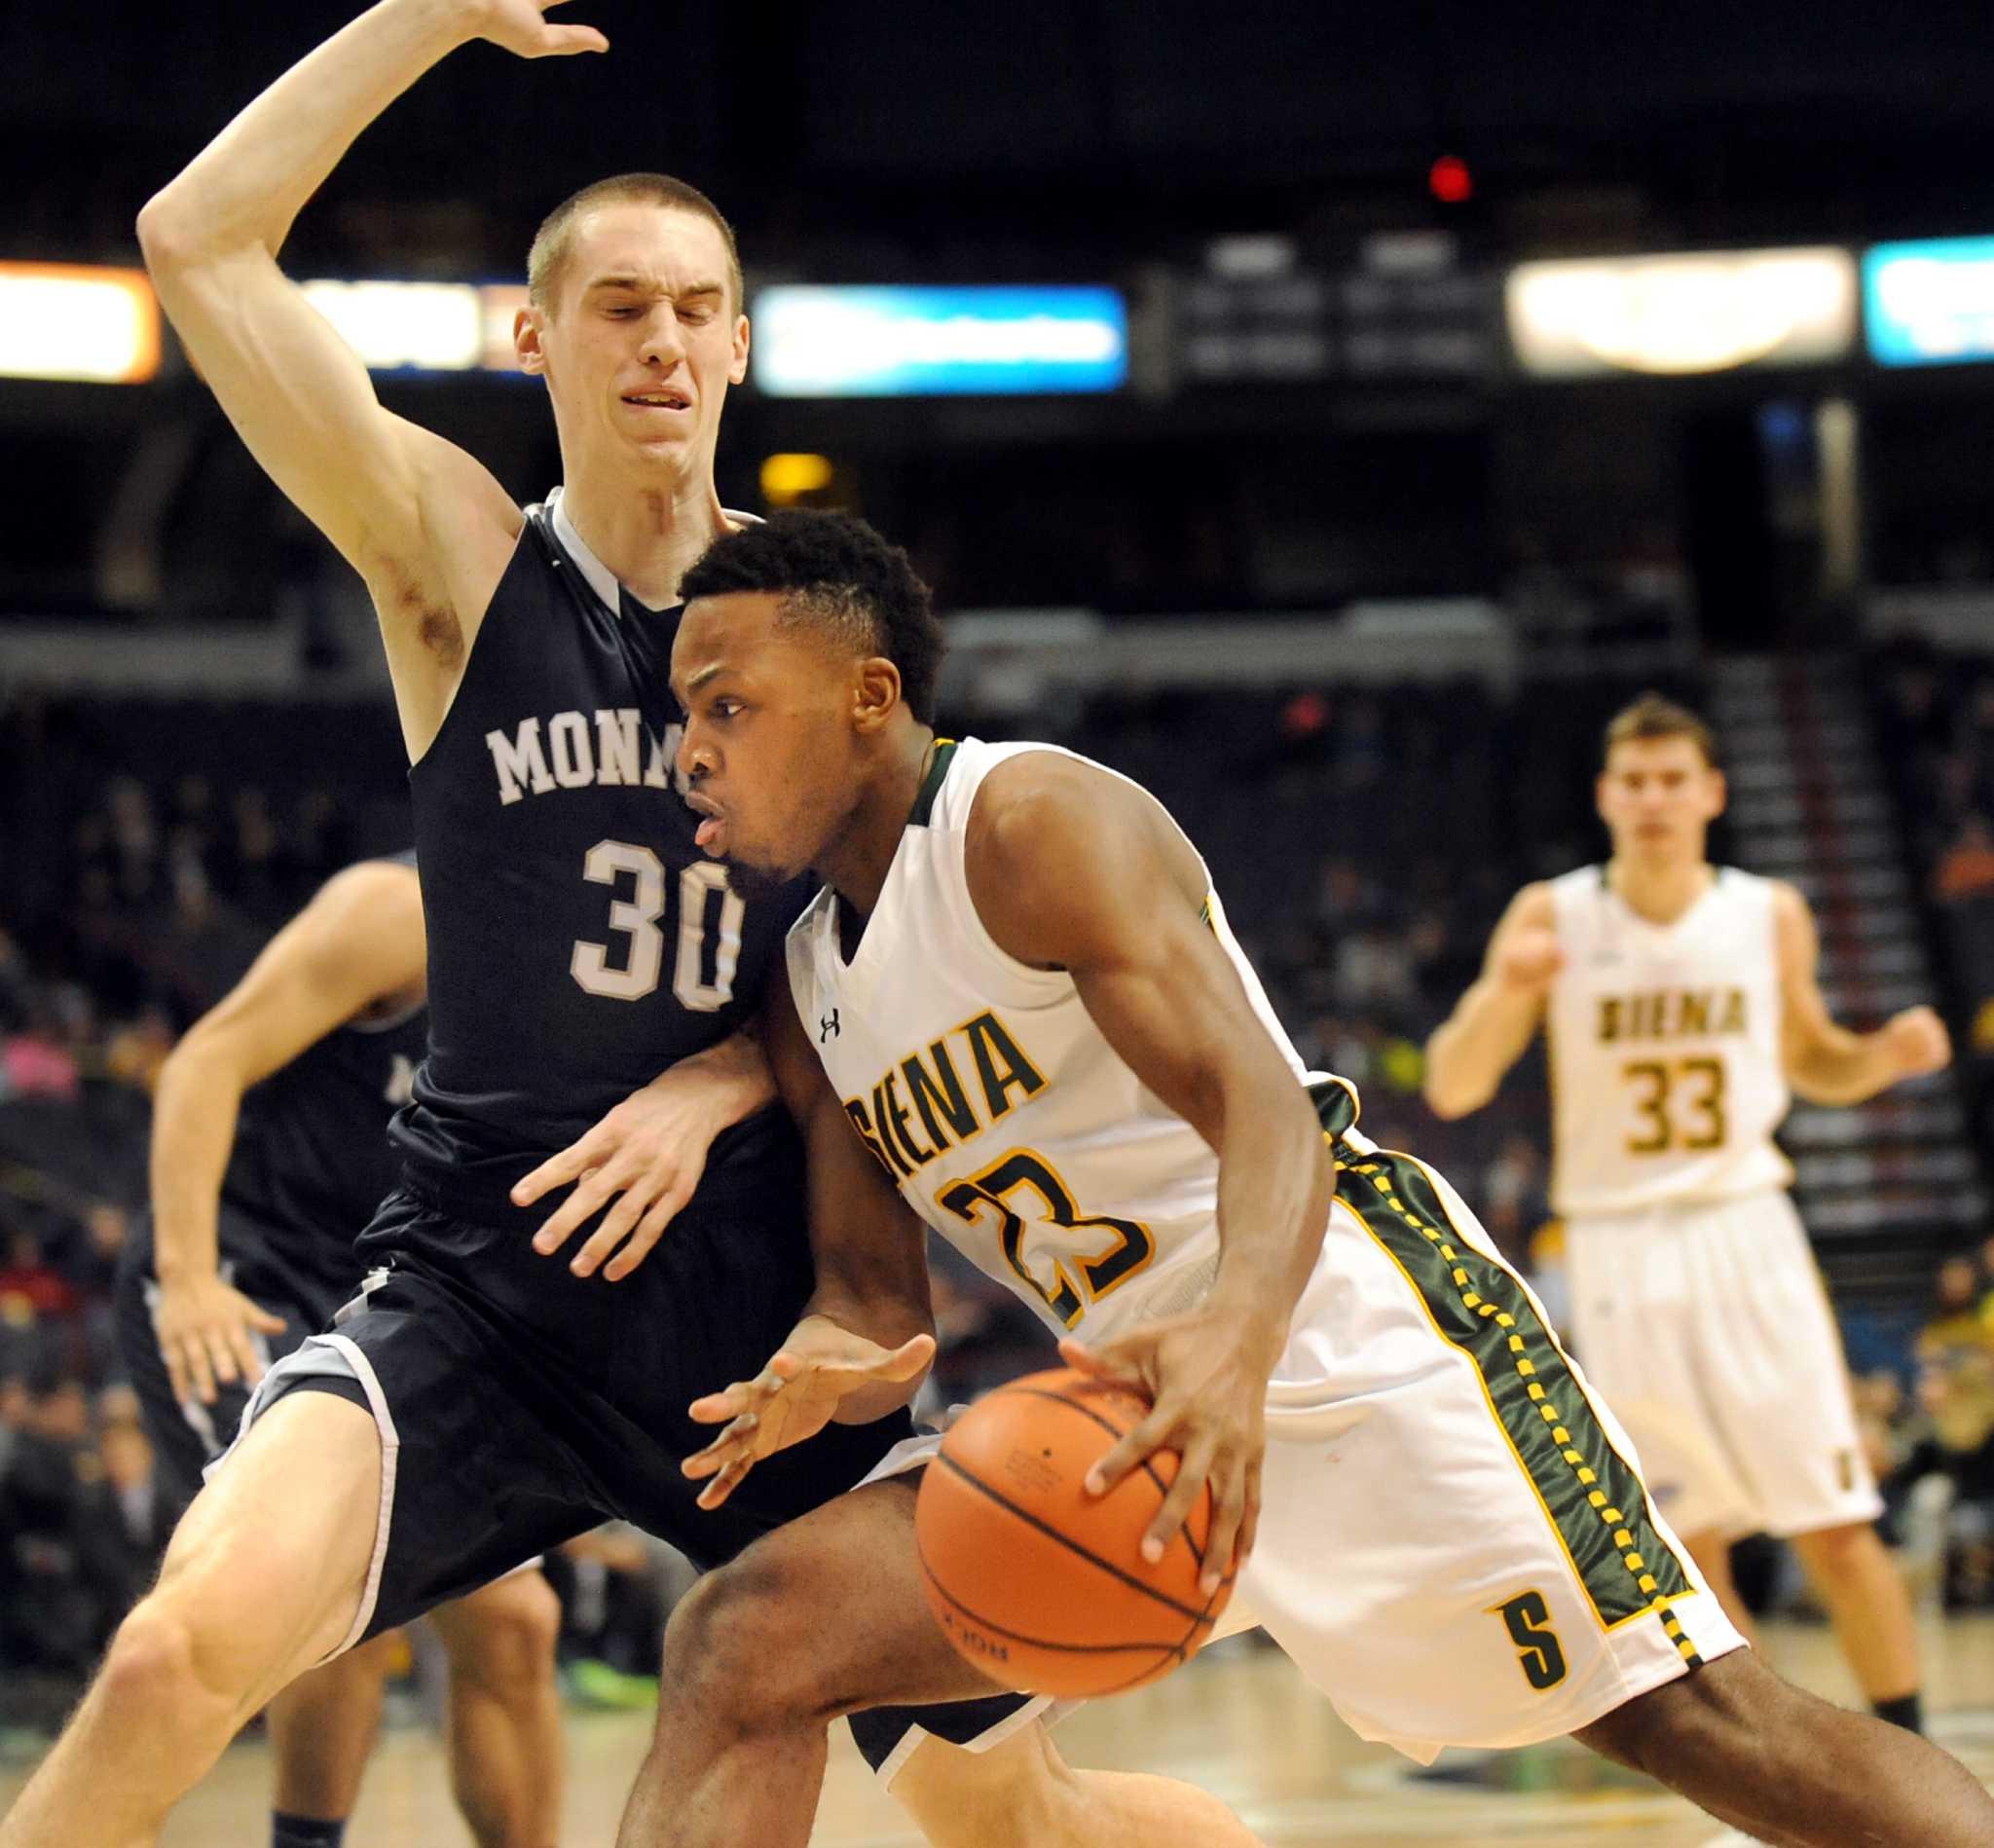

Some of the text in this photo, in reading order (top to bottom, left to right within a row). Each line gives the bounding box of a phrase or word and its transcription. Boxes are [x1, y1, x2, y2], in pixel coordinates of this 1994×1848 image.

[570, 839, 747, 1013] 30
[843, 1007, 1052, 1189] SIENA
[1621, 1053, 1727, 1156] 33
[934, 1146, 1157, 1331] 23
[1482, 1587, 1569, 1695] S
